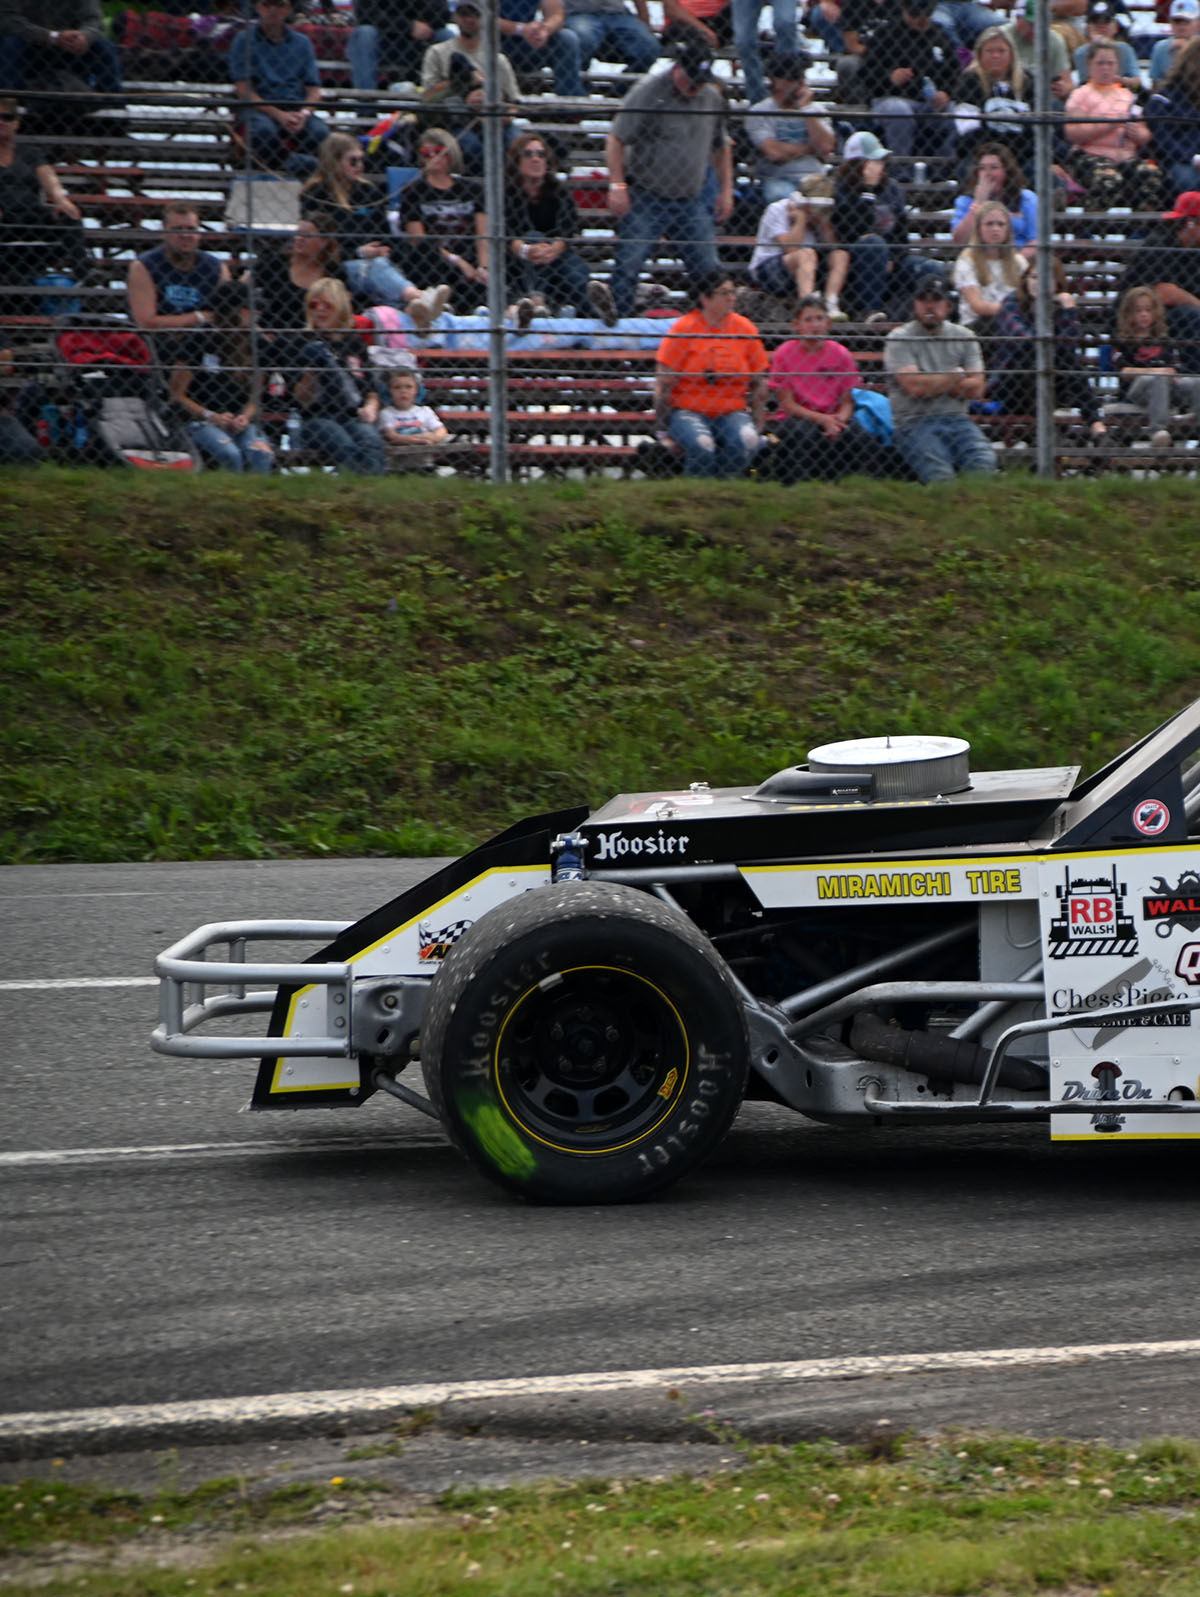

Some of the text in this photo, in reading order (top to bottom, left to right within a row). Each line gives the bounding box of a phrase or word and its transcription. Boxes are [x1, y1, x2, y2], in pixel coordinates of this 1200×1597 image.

[593, 829, 690, 860] Hoosier
[817, 869, 1022, 899] MIRAMICHI TIRE
[1070, 898, 1114, 924] RB
[1072, 925, 1115, 935] WALSH
[1141, 1015, 1151, 1026] &
[1122, 1079, 1152, 1099] On
